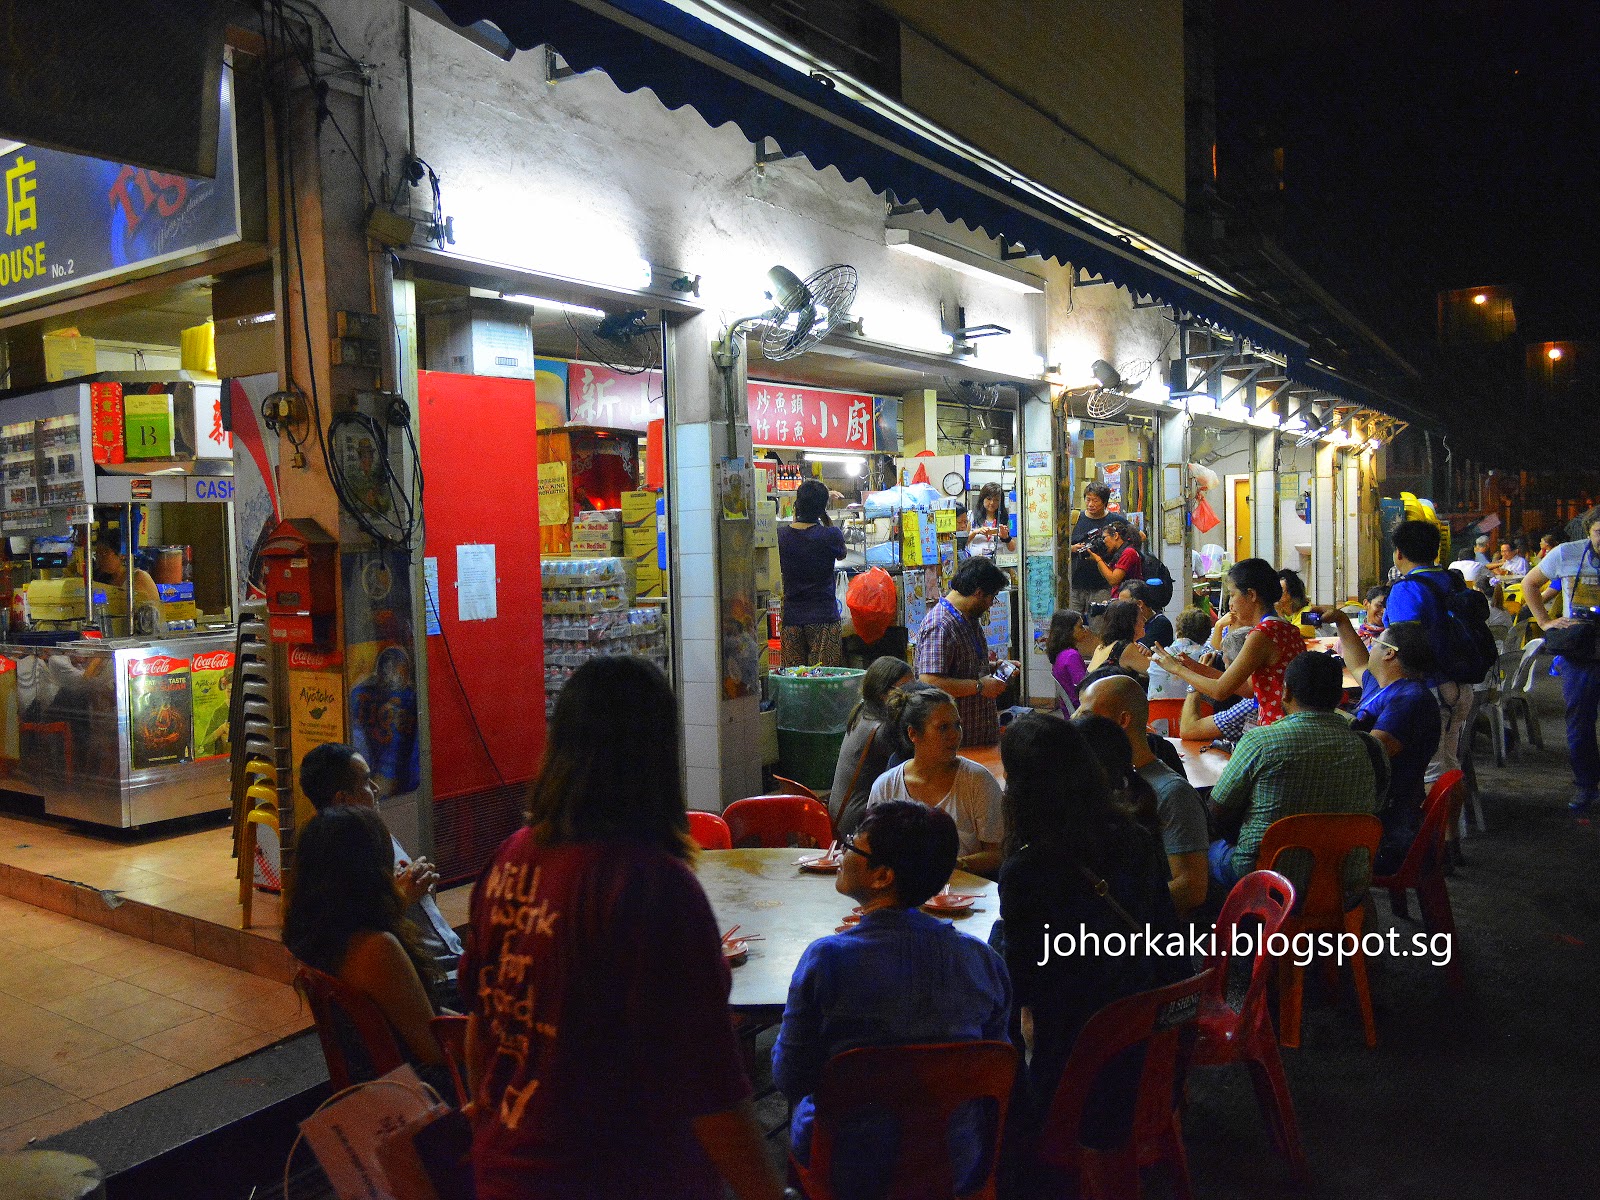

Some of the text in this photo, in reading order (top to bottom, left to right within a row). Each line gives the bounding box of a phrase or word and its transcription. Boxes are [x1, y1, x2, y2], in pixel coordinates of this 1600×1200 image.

[5, 156, 38, 237] 店
[0, 241, 47, 287] OUSE
[756, 389, 805, 417] 炒魚頭
[140, 425, 157, 446] 13
[756, 418, 806, 444] 竹仔魚
